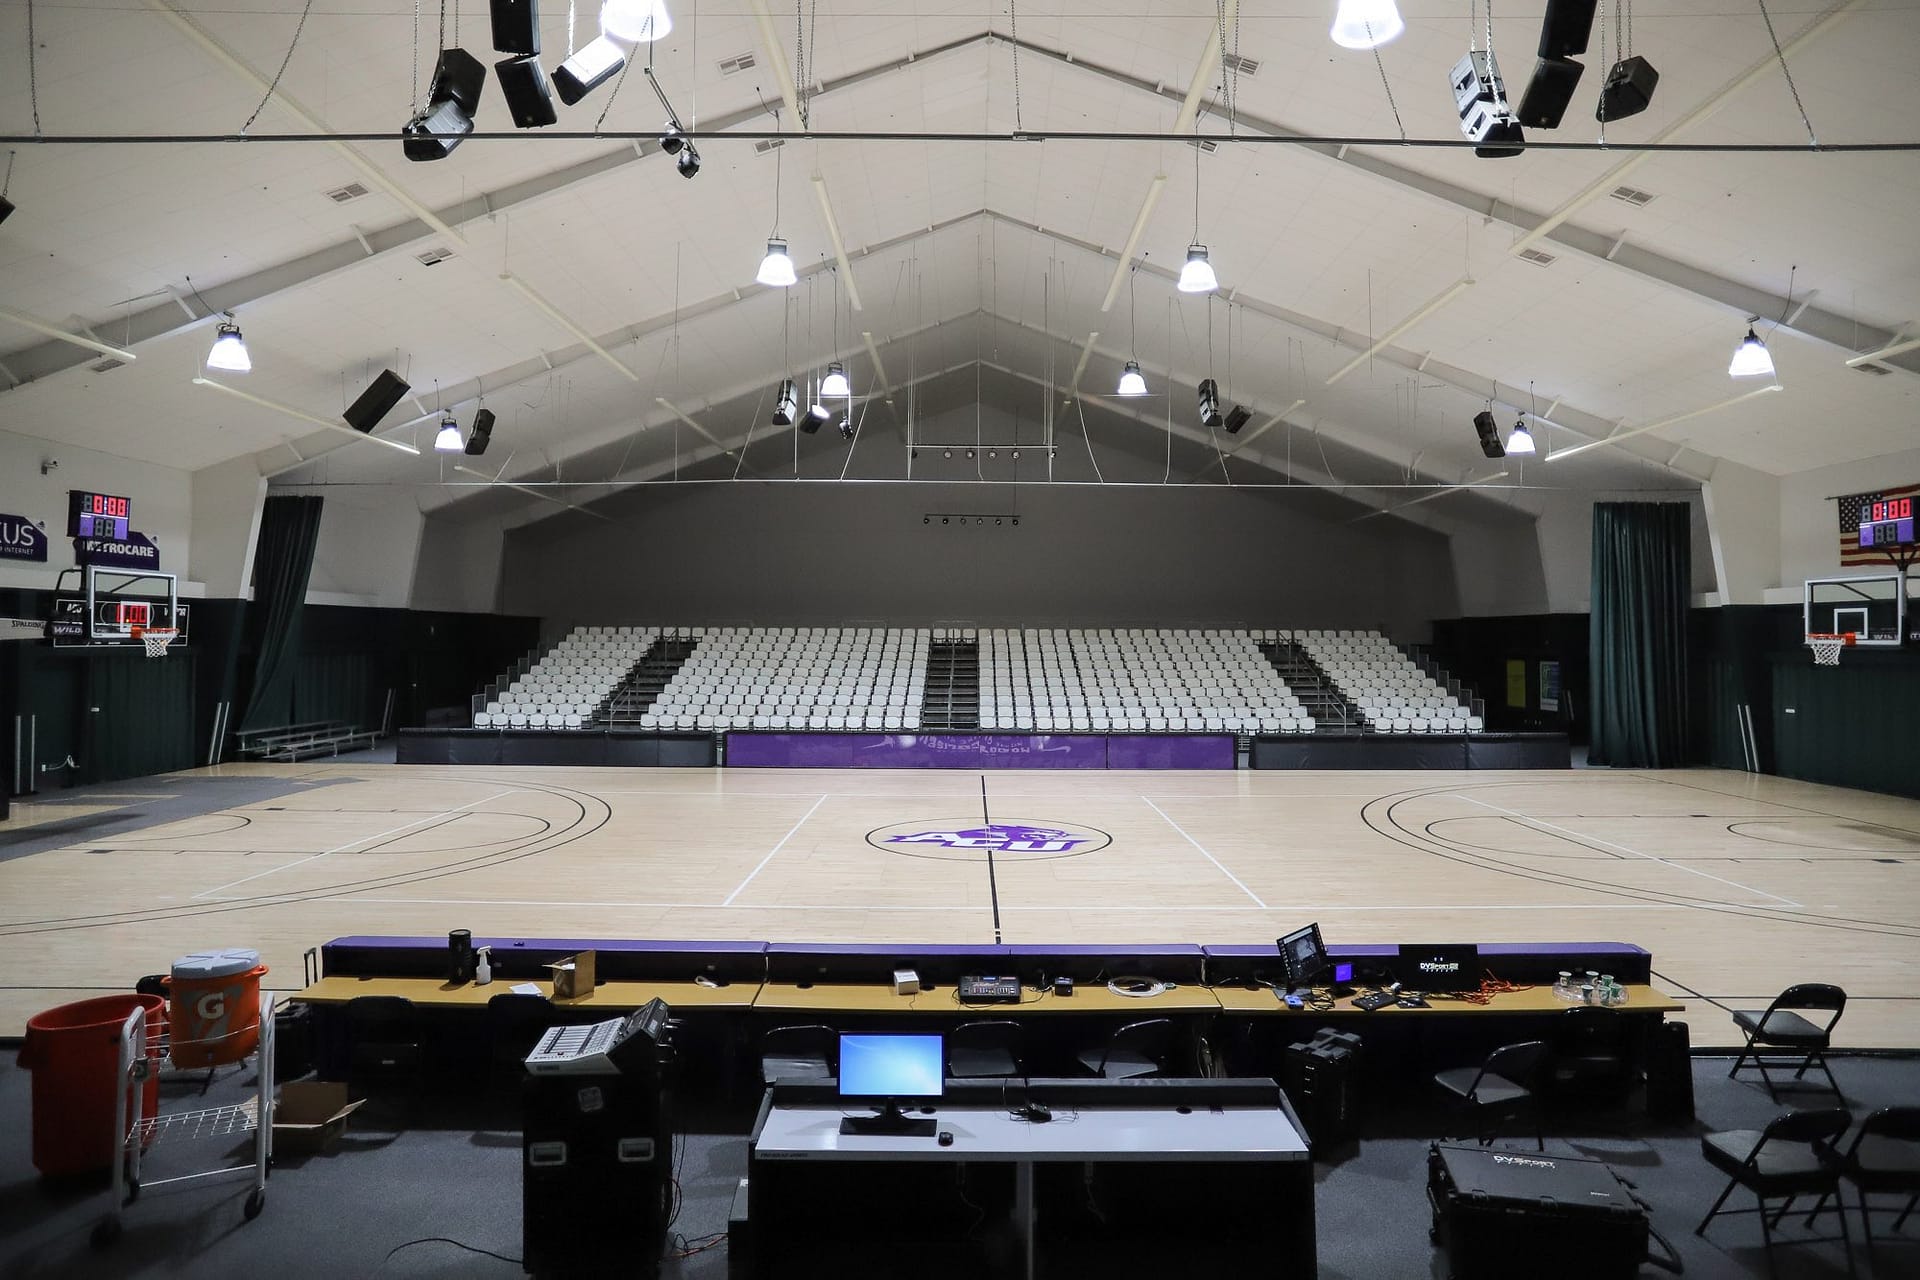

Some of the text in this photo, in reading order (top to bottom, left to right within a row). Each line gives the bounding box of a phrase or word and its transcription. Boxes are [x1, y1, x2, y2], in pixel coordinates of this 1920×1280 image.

[0, 522, 34, 546] US
[893, 829, 1080, 851] ACU
[197, 991, 224, 1020] G
